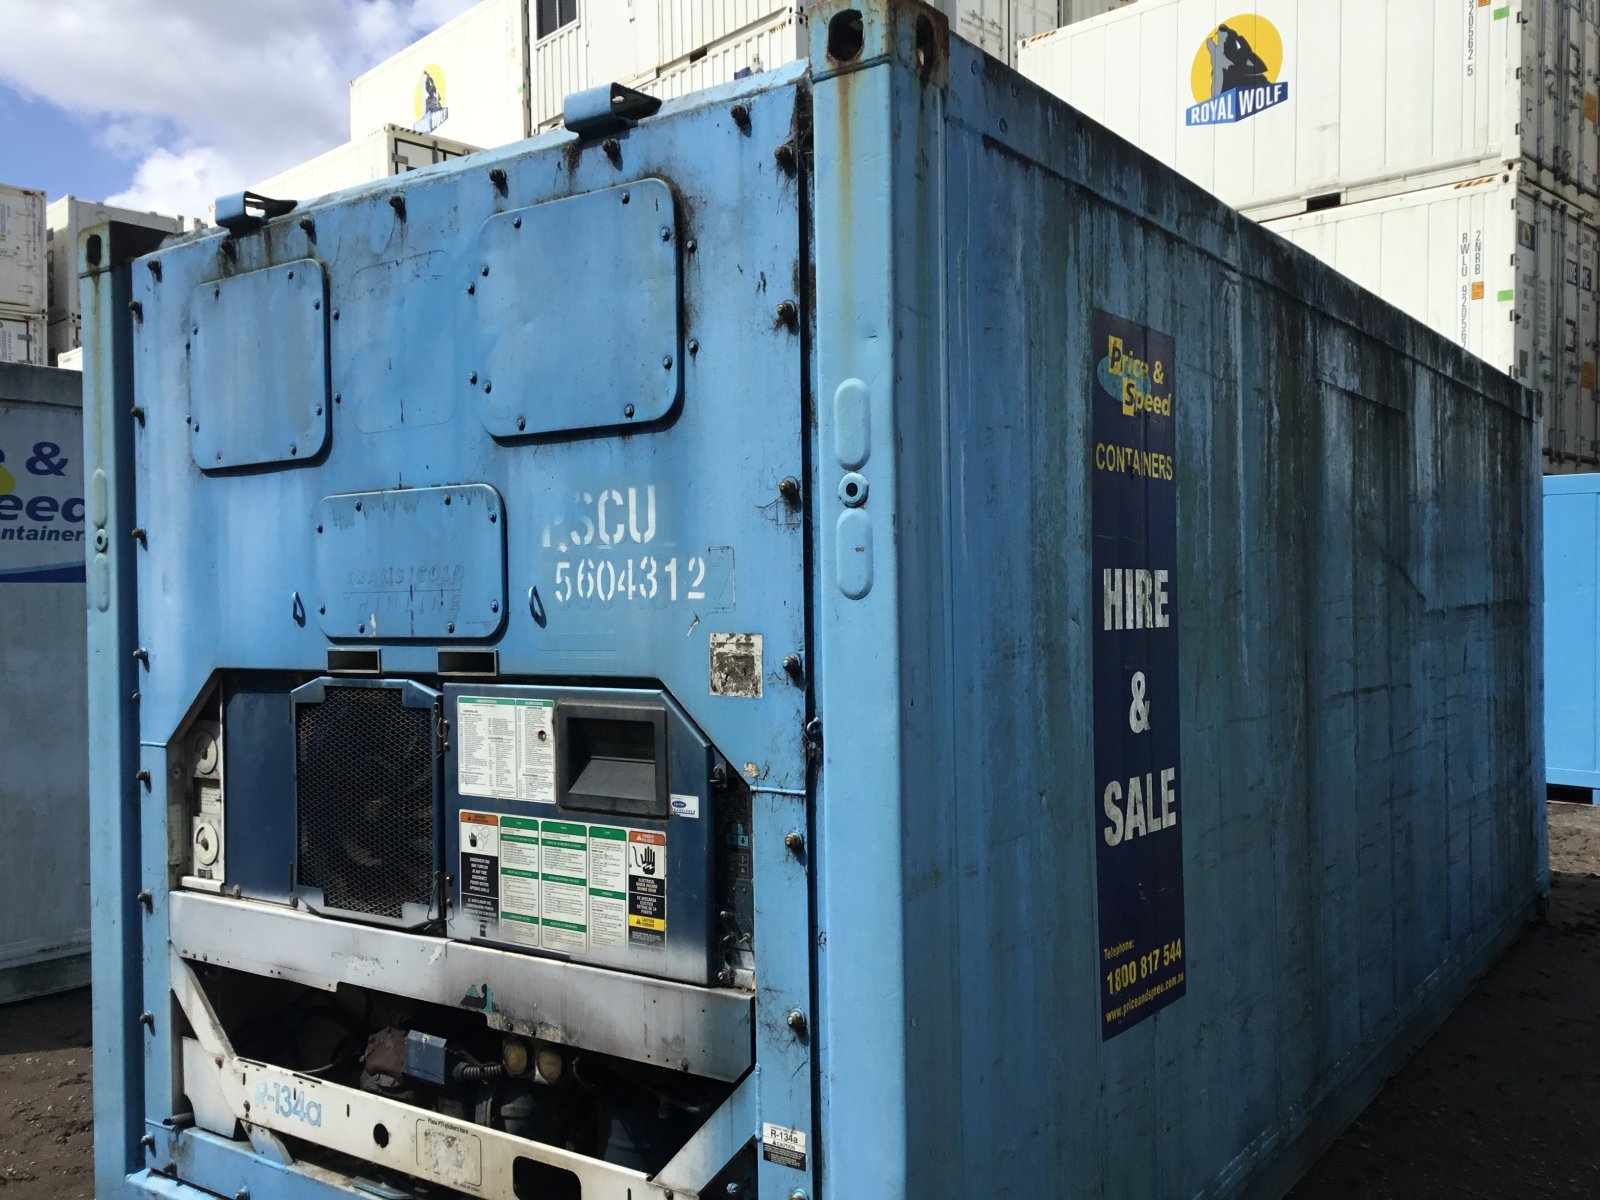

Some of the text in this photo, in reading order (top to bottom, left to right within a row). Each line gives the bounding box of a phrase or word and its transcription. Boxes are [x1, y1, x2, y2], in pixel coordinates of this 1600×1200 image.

[1467, 0, 1475, 60] 20562
[1191, 84, 1282, 124] ROYAL WOLF
[1460, 233, 1470, 277] RWLU
[1109, 343, 1164, 385] Price &
[1124, 383, 1172, 417] Speed
[26, 441, 69, 477] &
[1095, 442, 1173, 481] CONTAINERS
[555, 556, 706, 602] 5604312
[1103, 568, 1169, 631] HIRE
[1129, 671, 1151, 734] &
[1103, 767, 1177, 847] SALE
[1106, 938, 1182, 995] 1800 817 544
[256, 1081, 322, 1128] R-134a
[770, 1129, 798, 1144] R-134a
